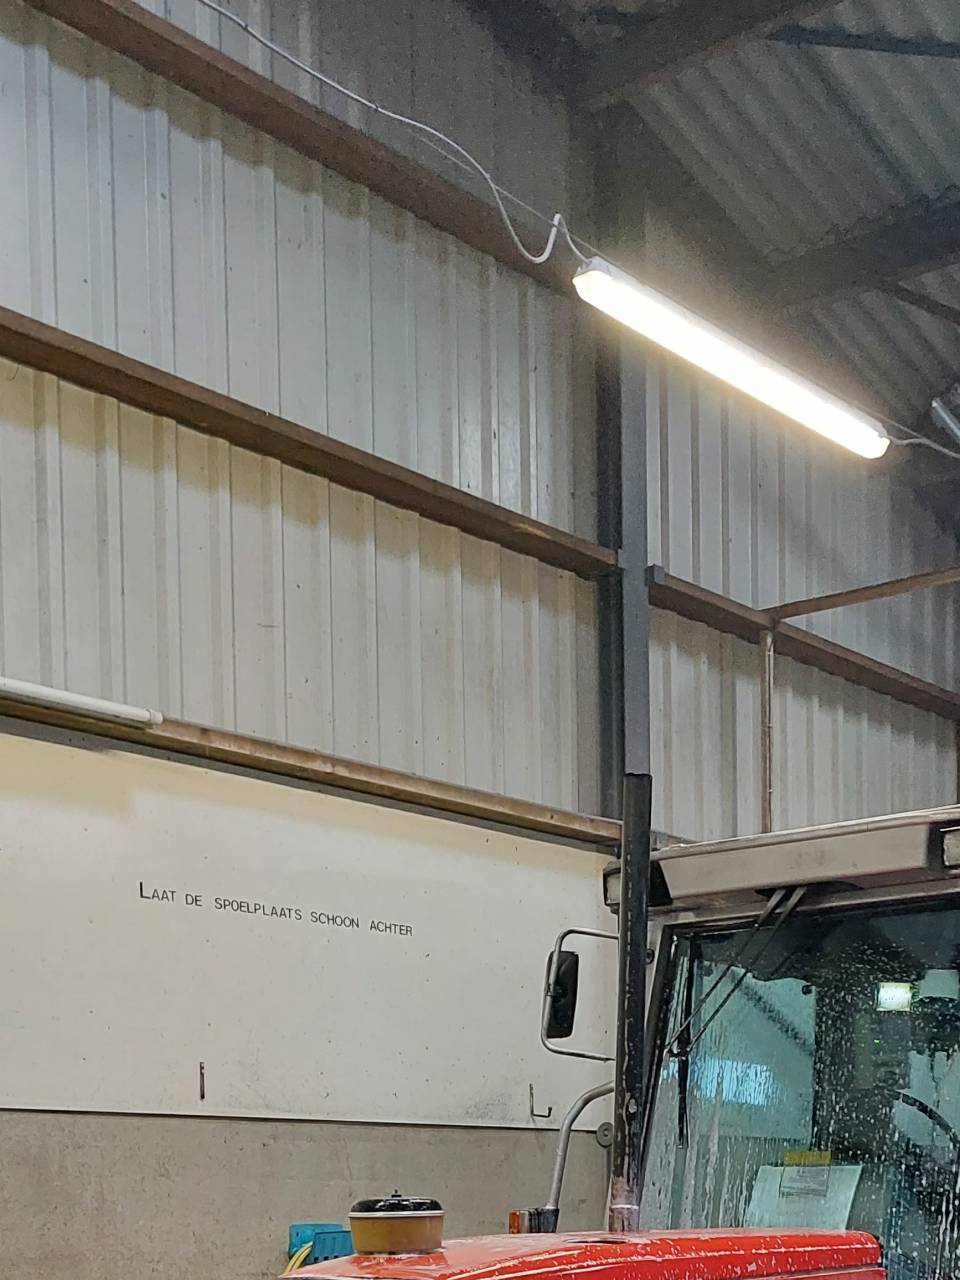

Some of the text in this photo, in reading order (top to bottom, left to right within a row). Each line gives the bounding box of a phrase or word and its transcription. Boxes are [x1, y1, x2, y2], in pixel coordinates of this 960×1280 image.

[185, 893, 203, 907] DE
[214, 897, 302, 921] SPOELPLAATS
[310, 911, 360, 929] SCHOON
[370, 920, 413, 936] ACHTER
